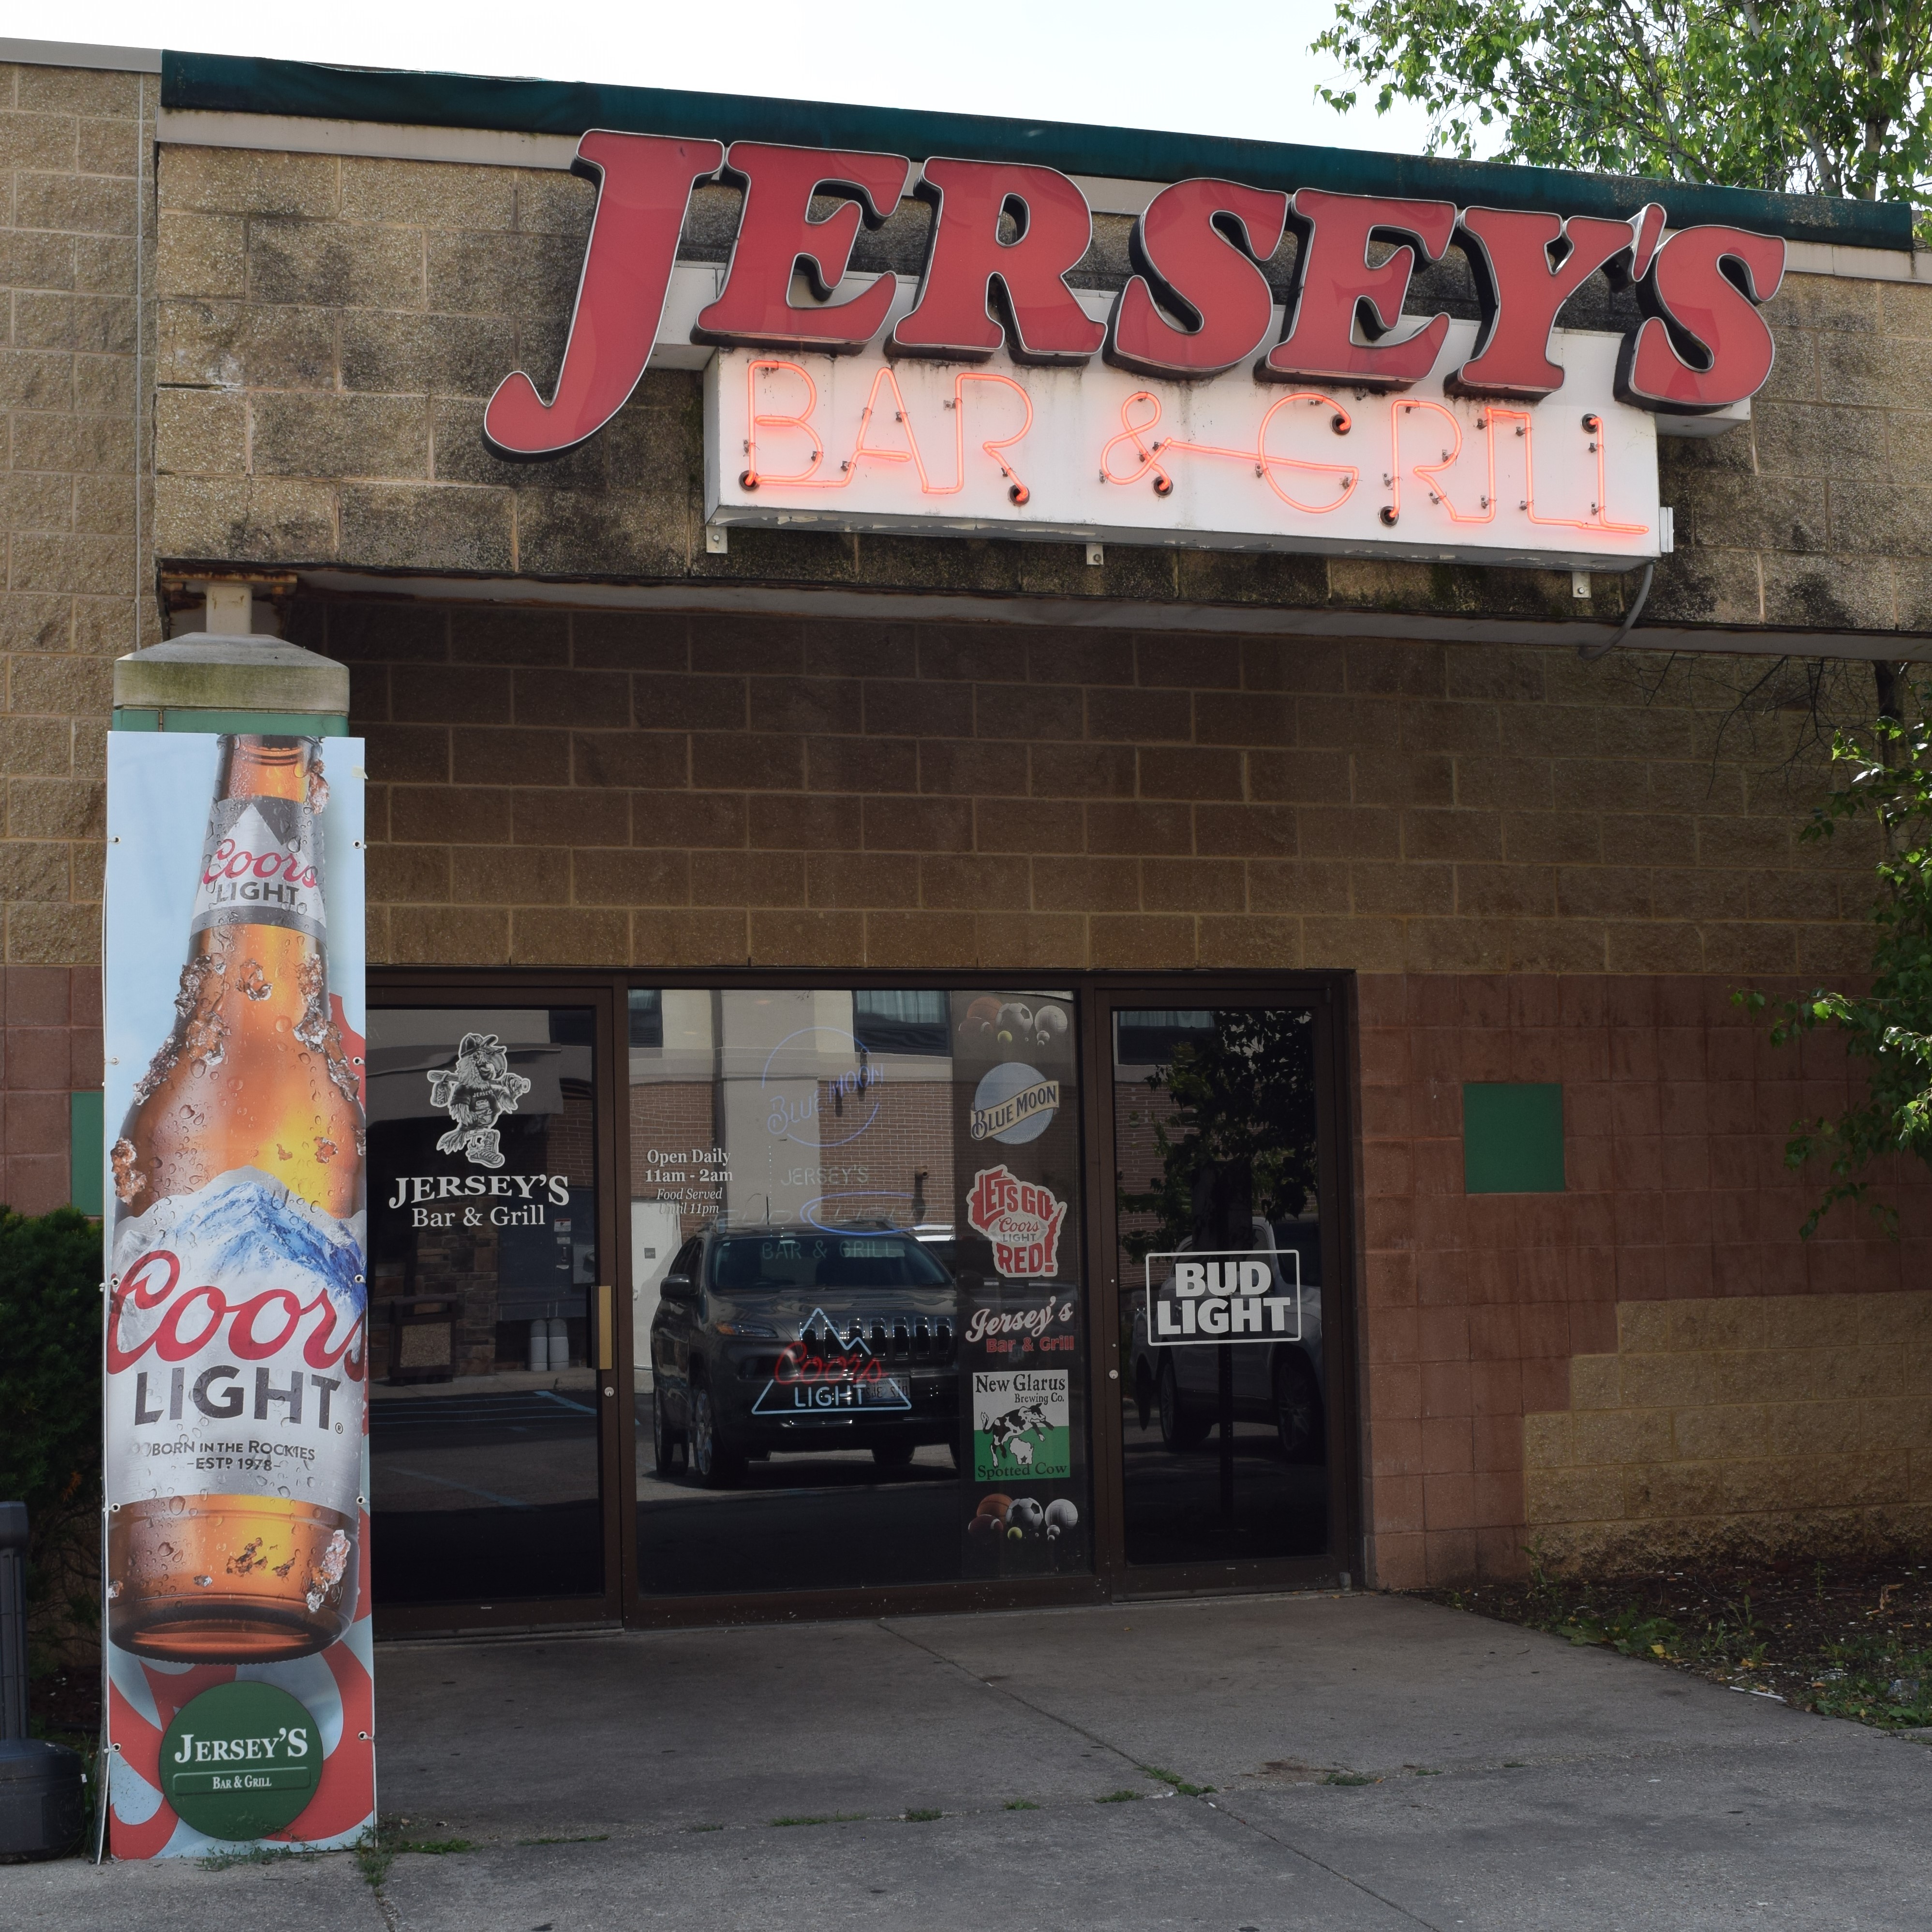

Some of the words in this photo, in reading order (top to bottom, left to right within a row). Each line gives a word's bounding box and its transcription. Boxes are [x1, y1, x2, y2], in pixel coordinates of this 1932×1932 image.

[483, 128, 1786, 457] JERSEY'S
[748, 360, 1033, 501] BAR
[1100, 392, 1170, 491] &
[203, 839, 317, 888] Coors
[216, 881, 299, 906] LIGHT
[767, 1089, 823, 1135] BLUE
[829, 1064, 884, 1103] MOON
[971, 1110, 1013, 1140] BLUE
[1016, 1085, 1056, 1117] MOON
[647, 1149, 687, 1167] Open
[692, 1148, 731, 1166] Daily
[645, 1170, 685, 1182] 11am
[699, 1169, 733, 1182] 2am
[780, 1164, 869, 1186] JERSEY'S
[389, 1174, 569, 1209] JERSEY'S
[656, 1188, 684, 1200] Food
[685, 1187, 722, 1200] Served
[1021, 1185, 1054, 1221] GO
[412, 1208, 455, 1227] Bar
[463, 1207, 483, 1226] &
[490, 1205, 546, 1226] Grill
[661, 1202, 687, 1214] Until
[689, 1203, 719, 1216] 11pm
[998, 1217, 1040, 1233] Coors
[1002, 1233, 1036, 1242] LIGHT
[762, 1241, 802, 1259] BAR
[813, 1241, 827, 1258] &
[839, 1240, 891, 1257] GRILL
[1175, 1261, 1271, 1297] BUD
[107, 1249, 367, 1382] Coors
[966, 1296, 1073, 1342] Jersey's
[1157, 1297, 1291, 1335] LIGHT
[986, 1338, 1016, 1352] Bar
[1022, 1337, 1034, 1352] &
[1040, 1335, 1074, 1351] Grill
[775, 1341, 889, 1385] Coors
[975, 1374, 1010, 1393] New
[1013, 1374, 1066, 1392] Glarus
[134, 1365, 341, 1430] LIGHT
[794, 1384, 866, 1407] LIGHT
[1014, 1393, 1049, 1405] Brewing
[1051, 1392, 1065, 1403] Co.
[152, 1441, 195, 1456] BORN
[200, 1443, 216, 1452] IN
[217, 1442, 243, 1453] THE
[248, 1441, 315, 1460] ROCKIES
[978, 1462, 1030, 1480] Spotted
[1035, 1463, 1067, 1475] Cow
[175, 1727, 308, 1763] JERSEY'S
[233, 1775, 242, 1788] &
